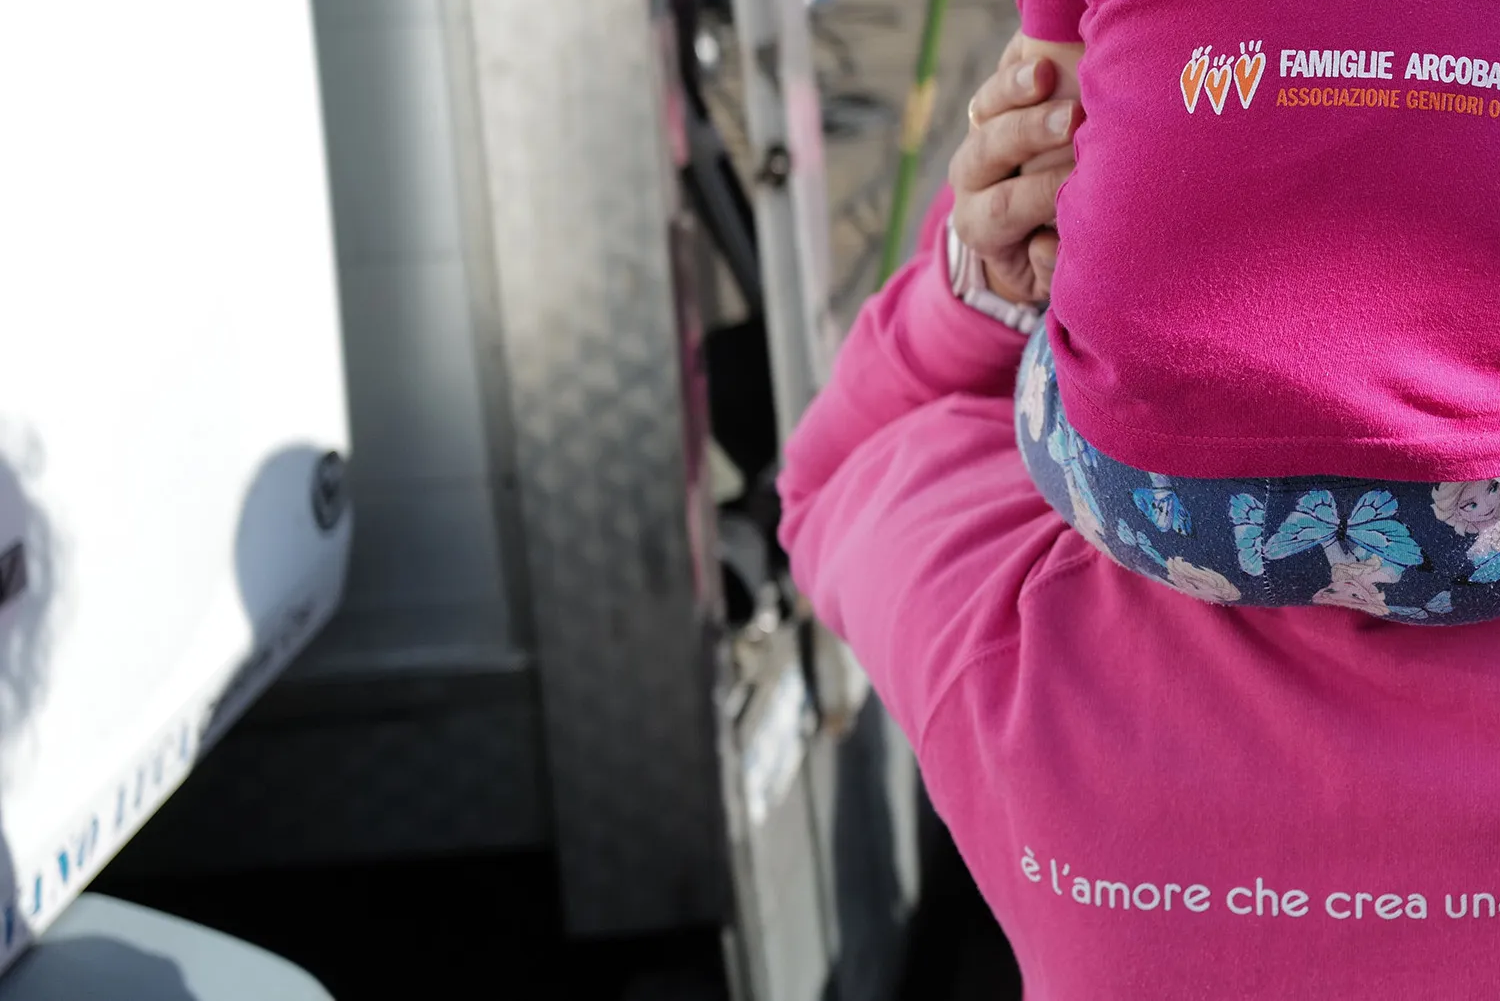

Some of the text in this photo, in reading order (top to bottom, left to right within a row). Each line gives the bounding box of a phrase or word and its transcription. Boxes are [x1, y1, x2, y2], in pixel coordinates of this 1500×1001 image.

[1279, 48, 1395, 80] FAMIGLIE
[1275, 88, 1401, 109] ASSOCIAZIONE
[1406, 89, 1484, 117] GENITORI
[1020, 845, 1042, 883] è
[1050, 858, 1212, 913] l'amore
[1226, 876, 1310, 917] che
[1325, 890, 1428, 919] crea
